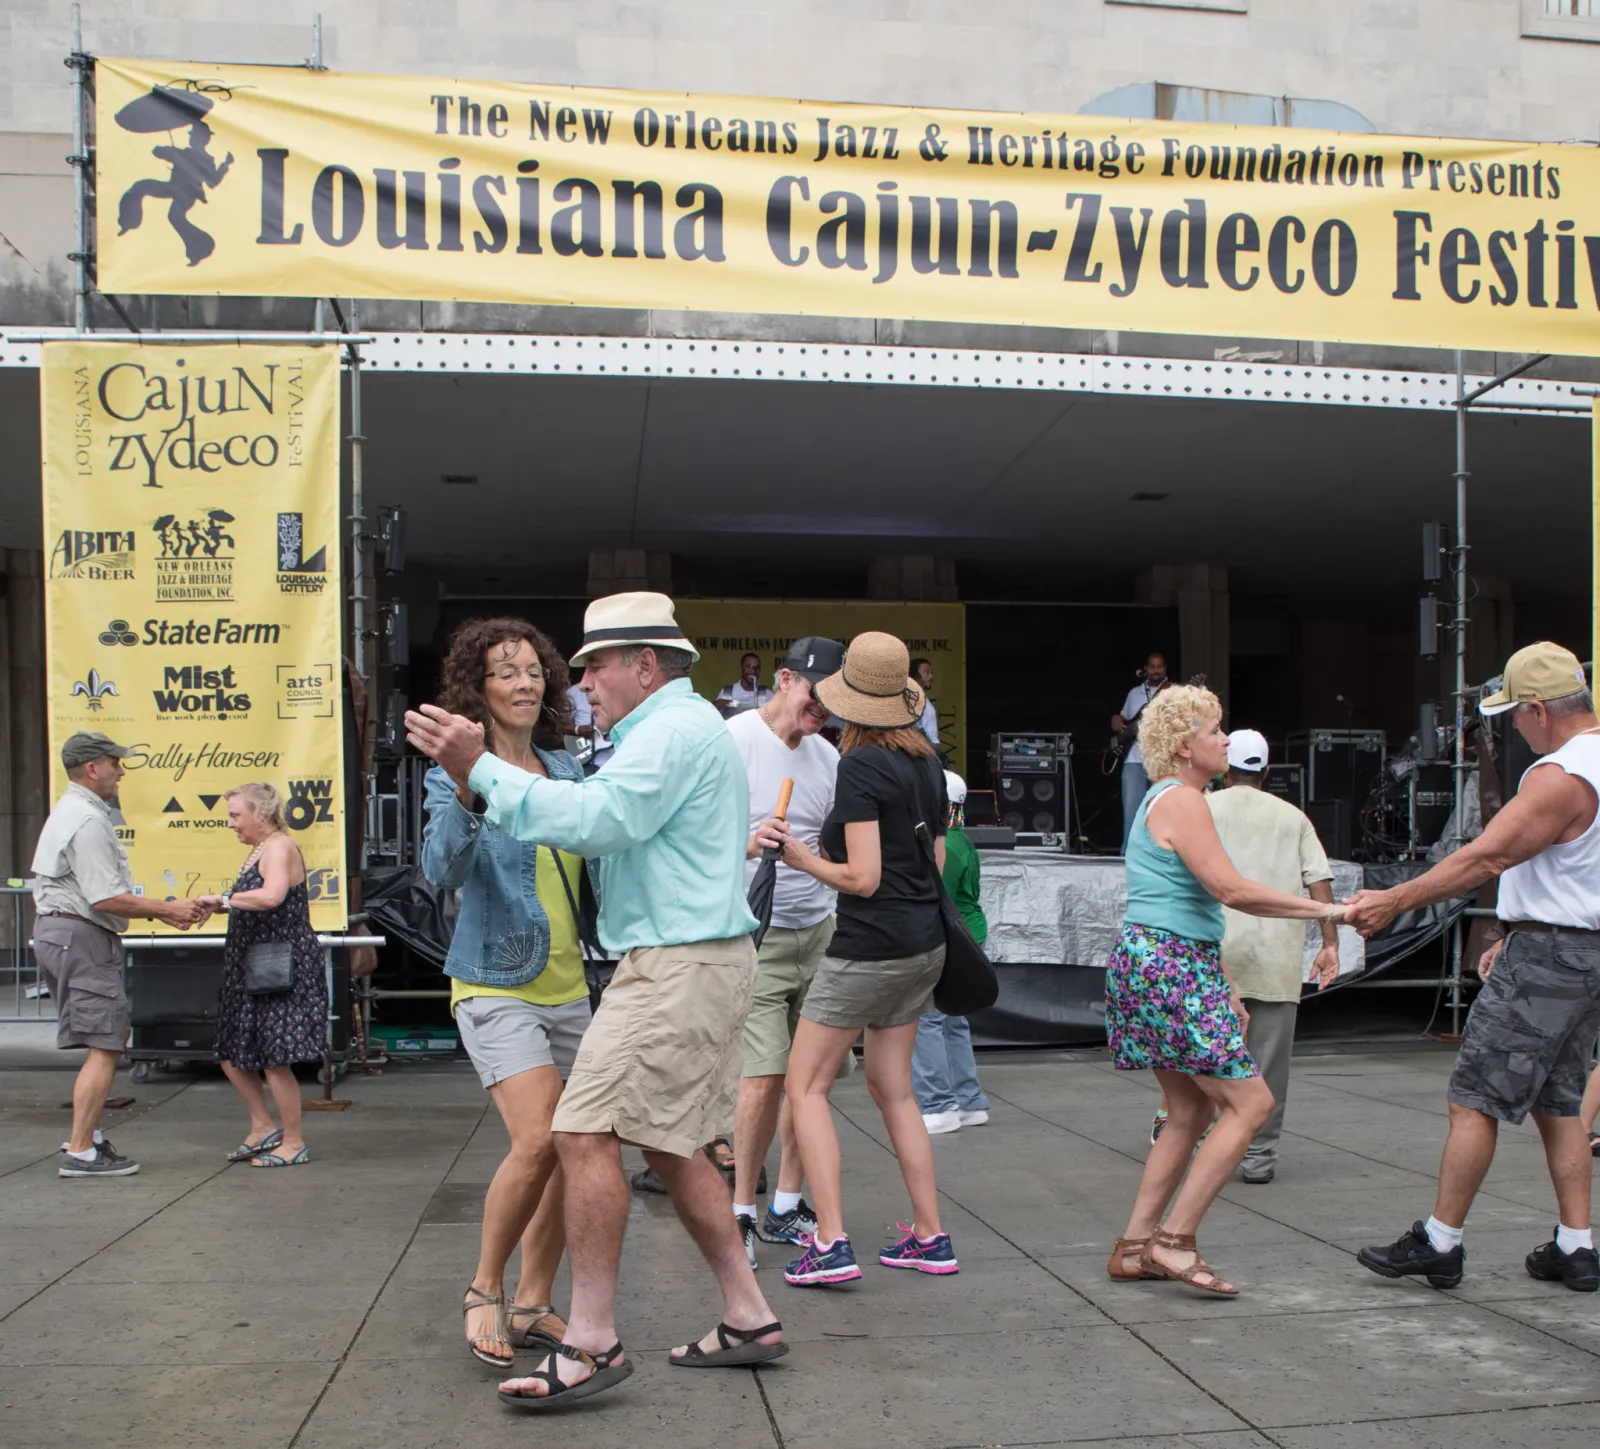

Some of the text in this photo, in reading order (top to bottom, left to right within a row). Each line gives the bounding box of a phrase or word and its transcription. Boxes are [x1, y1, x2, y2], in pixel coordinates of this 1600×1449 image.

[430, 95, 1561, 200] The New Orleans Jazz & Heritage Foundation Presents
[256, 147, 727, 262] Louisiana
[766, 175, 1357, 297] Cajun-Zydeco
[49, 529, 136, 579] ABITA
[88, 566, 136, 581] BEER
[157, 560, 234, 572] NEW ORLEANS
[157, 573, 233, 585] JAZZ & HERITAGE
[276, 574, 328, 584] LOUISIANA
[280, 583, 324, 593] LOTTERY
[722, 636, 772, 652] ORLEANS
[163, 664, 238, 690] Mist
[286, 675, 323, 689] arts
[152, 687, 252, 713] Works
[286, 689, 323, 697] COUNCIL
[121, 742, 281, 782] Sally Hansen
[167, 819, 229, 829] ART WOR
